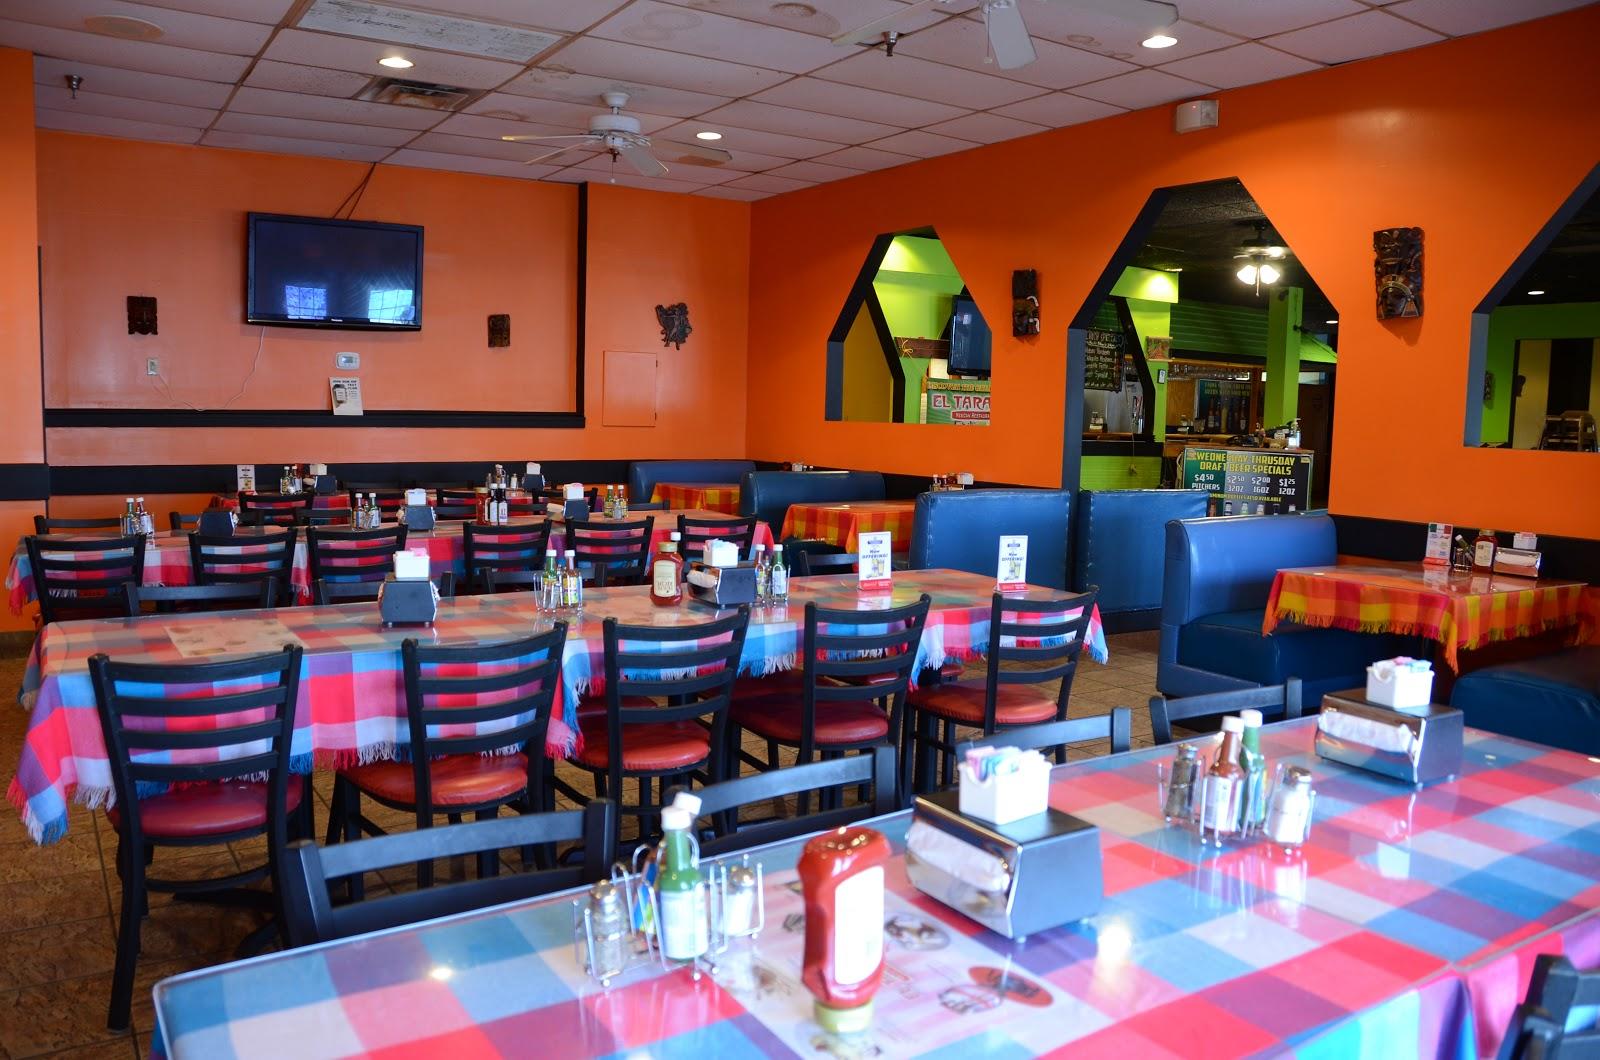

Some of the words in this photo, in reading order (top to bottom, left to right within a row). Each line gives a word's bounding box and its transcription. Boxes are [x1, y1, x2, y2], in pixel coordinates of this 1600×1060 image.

[932, 394, 951, 408] EL
[1251, 455, 1296, 466] THRUSDAY
[1200, 461, 1227, 471] DRAFT
[1229, 463, 1251, 472] BEER
[1252, 465, 1292, 476] SPECIALS
[1191, 482, 1220, 490] PITCHERS
